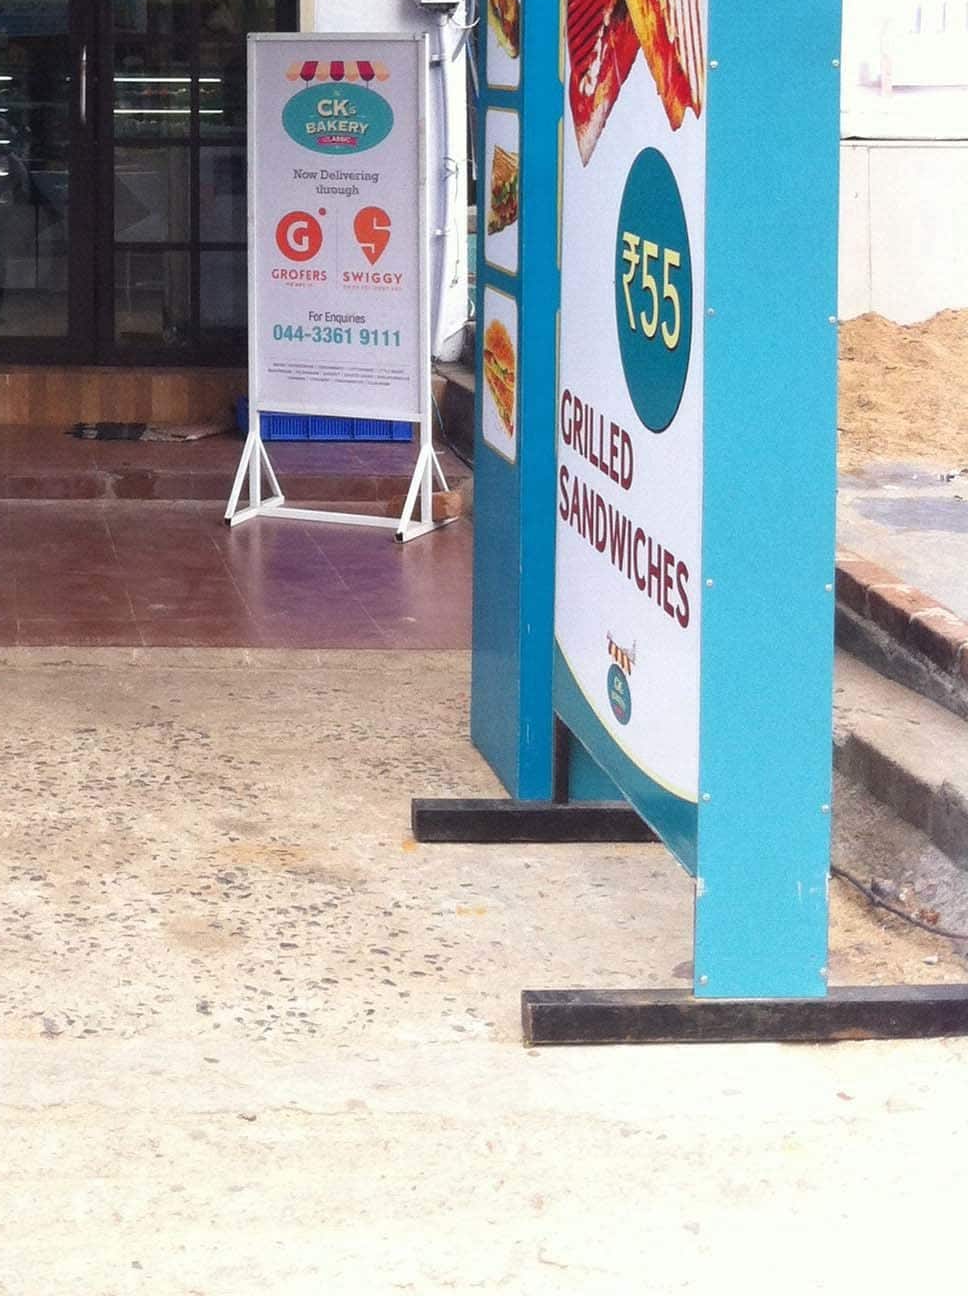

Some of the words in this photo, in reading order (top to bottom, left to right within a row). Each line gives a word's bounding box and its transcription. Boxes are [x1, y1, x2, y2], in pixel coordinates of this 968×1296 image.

[305, 120, 369, 135] BAKERY
[293, 169, 318, 181] Now
[320, 169, 379, 183] Delivering
[316, 185, 360, 197] through
[271, 268, 327, 281] GROFERS
[343, 271, 403, 284] SWIGGY
[308, 310, 323, 322] For
[325, 311, 366, 324] Enquiries
[272, 324, 352, 345] 044-3361
[359, 328, 401, 347] 9111
[560, 388, 634, 491] GRILLED
[559, 464, 690, 629] SANDWICHES
